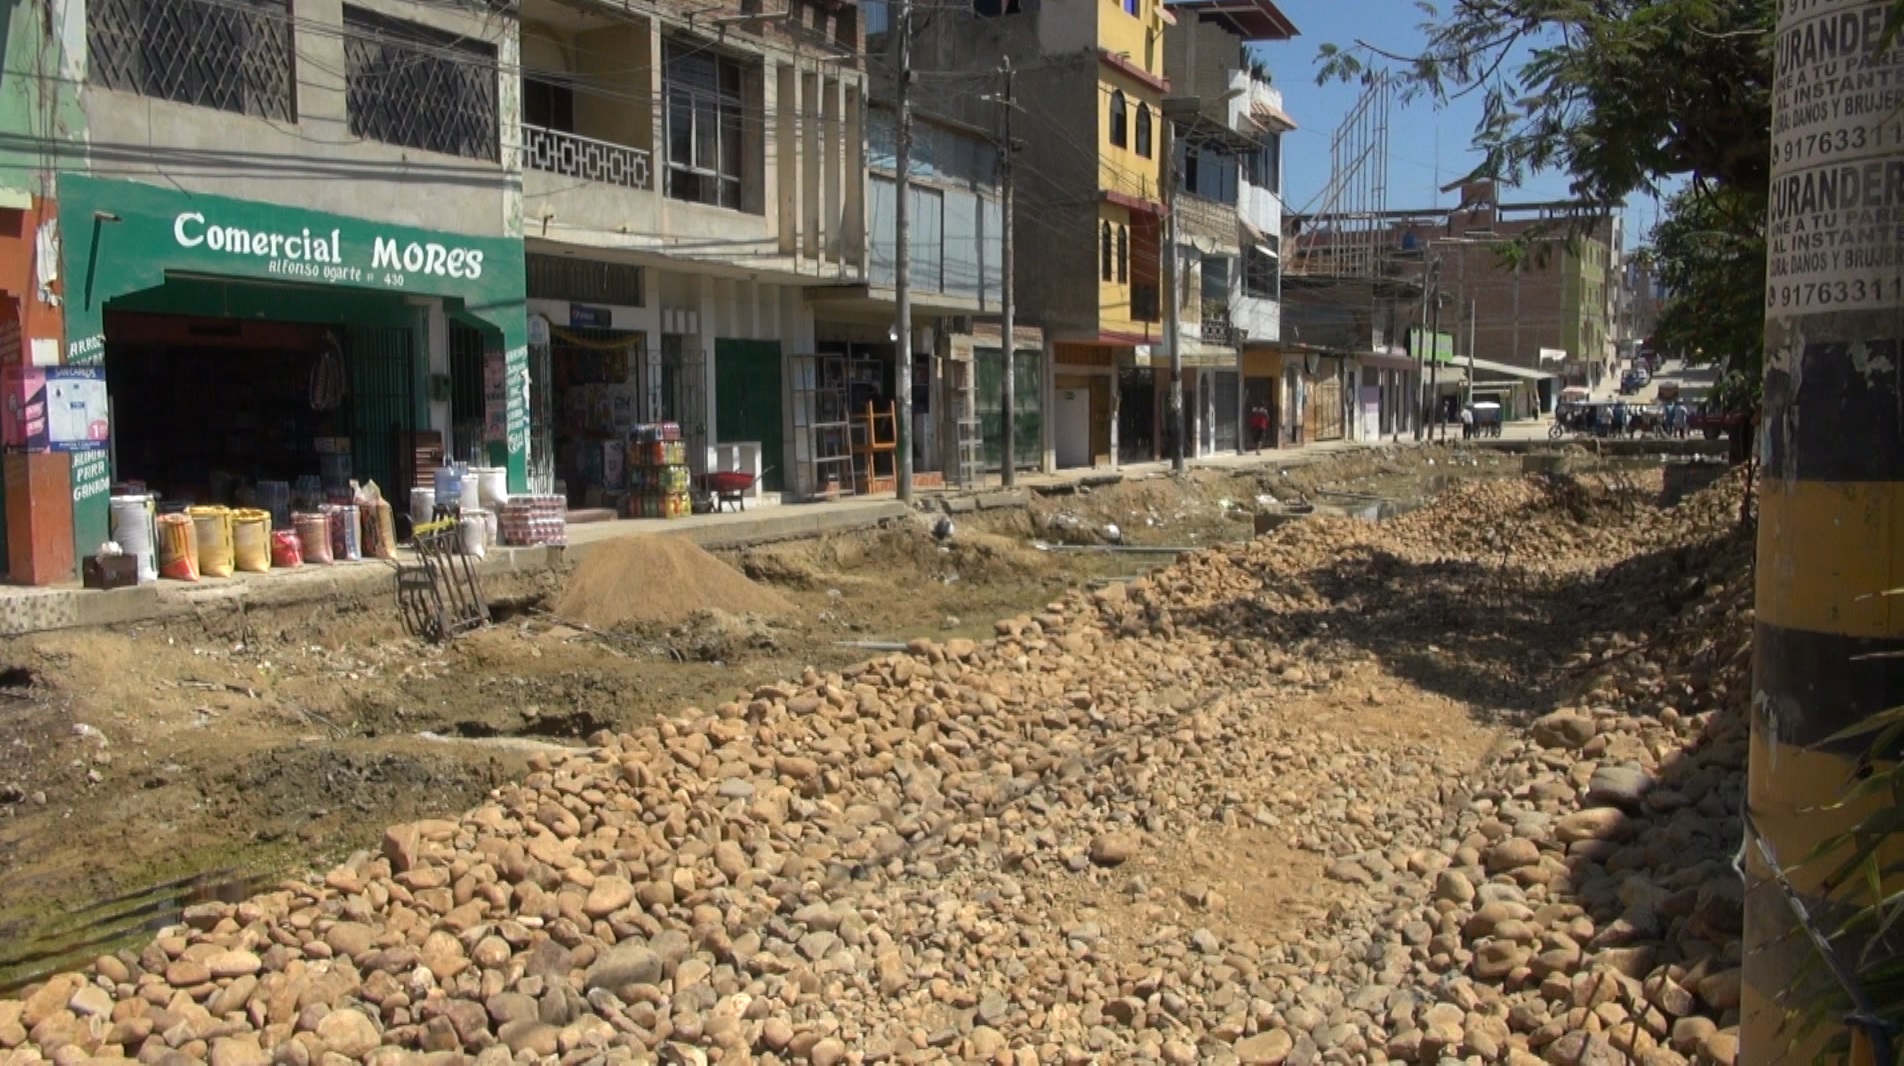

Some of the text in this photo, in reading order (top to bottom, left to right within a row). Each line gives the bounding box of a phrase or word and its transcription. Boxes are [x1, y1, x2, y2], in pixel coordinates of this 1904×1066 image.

[1776, 7, 1904, 78] URANDE
[1794, 68, 1904, 105] INSTANTE
[1797, 70, 1807, 85] A
[1812, 61, 1837, 80] TU
[1832, 98, 1840, 119] Y
[1795, 217, 1805, 232] A
[1811, 212, 1836, 230] TU
[174, 212, 342, 264] Comercial
[1773, 223, 1904, 254] AL INSTANTE
[1832, 248, 1840, 270] Y
[384, 273, 405, 287] 430
[1782, 275, 1901, 308] 91763311
